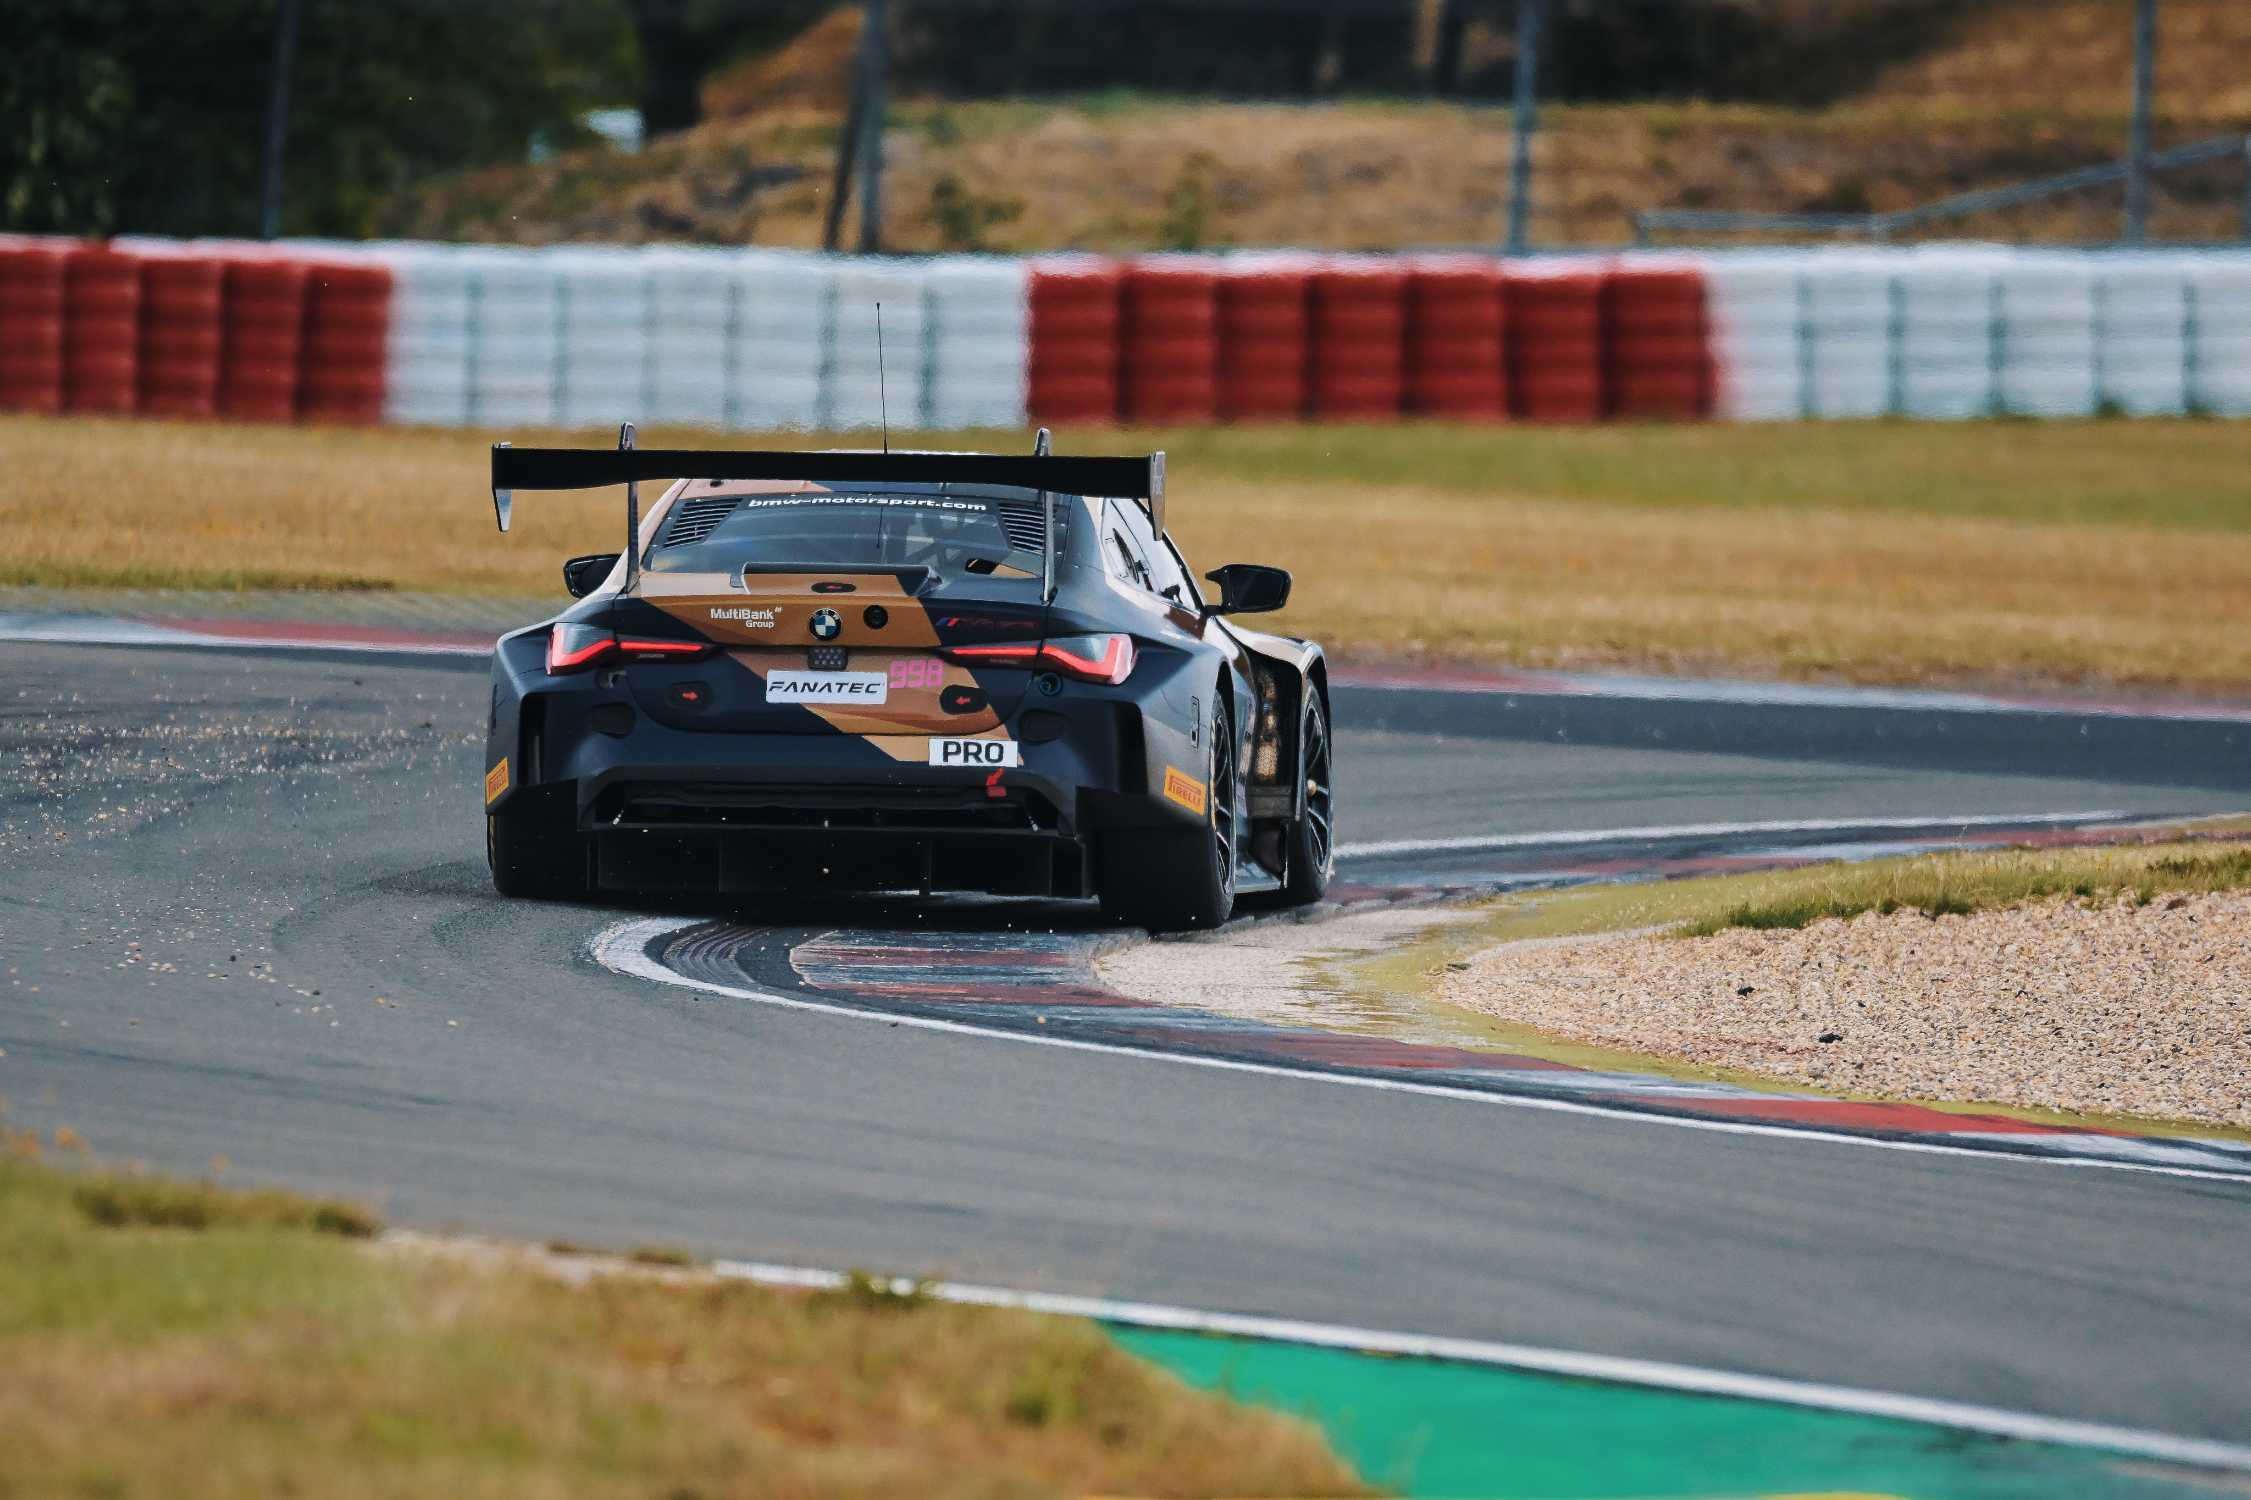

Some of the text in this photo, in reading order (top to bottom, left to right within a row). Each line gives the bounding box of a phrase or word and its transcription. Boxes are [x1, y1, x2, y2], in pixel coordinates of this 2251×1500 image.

[748, 497, 987, 511] bmw-motorsport.com
[710, 608, 775, 620] MultiBank
[745, 620, 775, 629] Group
[889, 658, 944, 689] 998
[769, 681, 881, 694] FANATEC
[942, 741, 1004, 764] PRO
